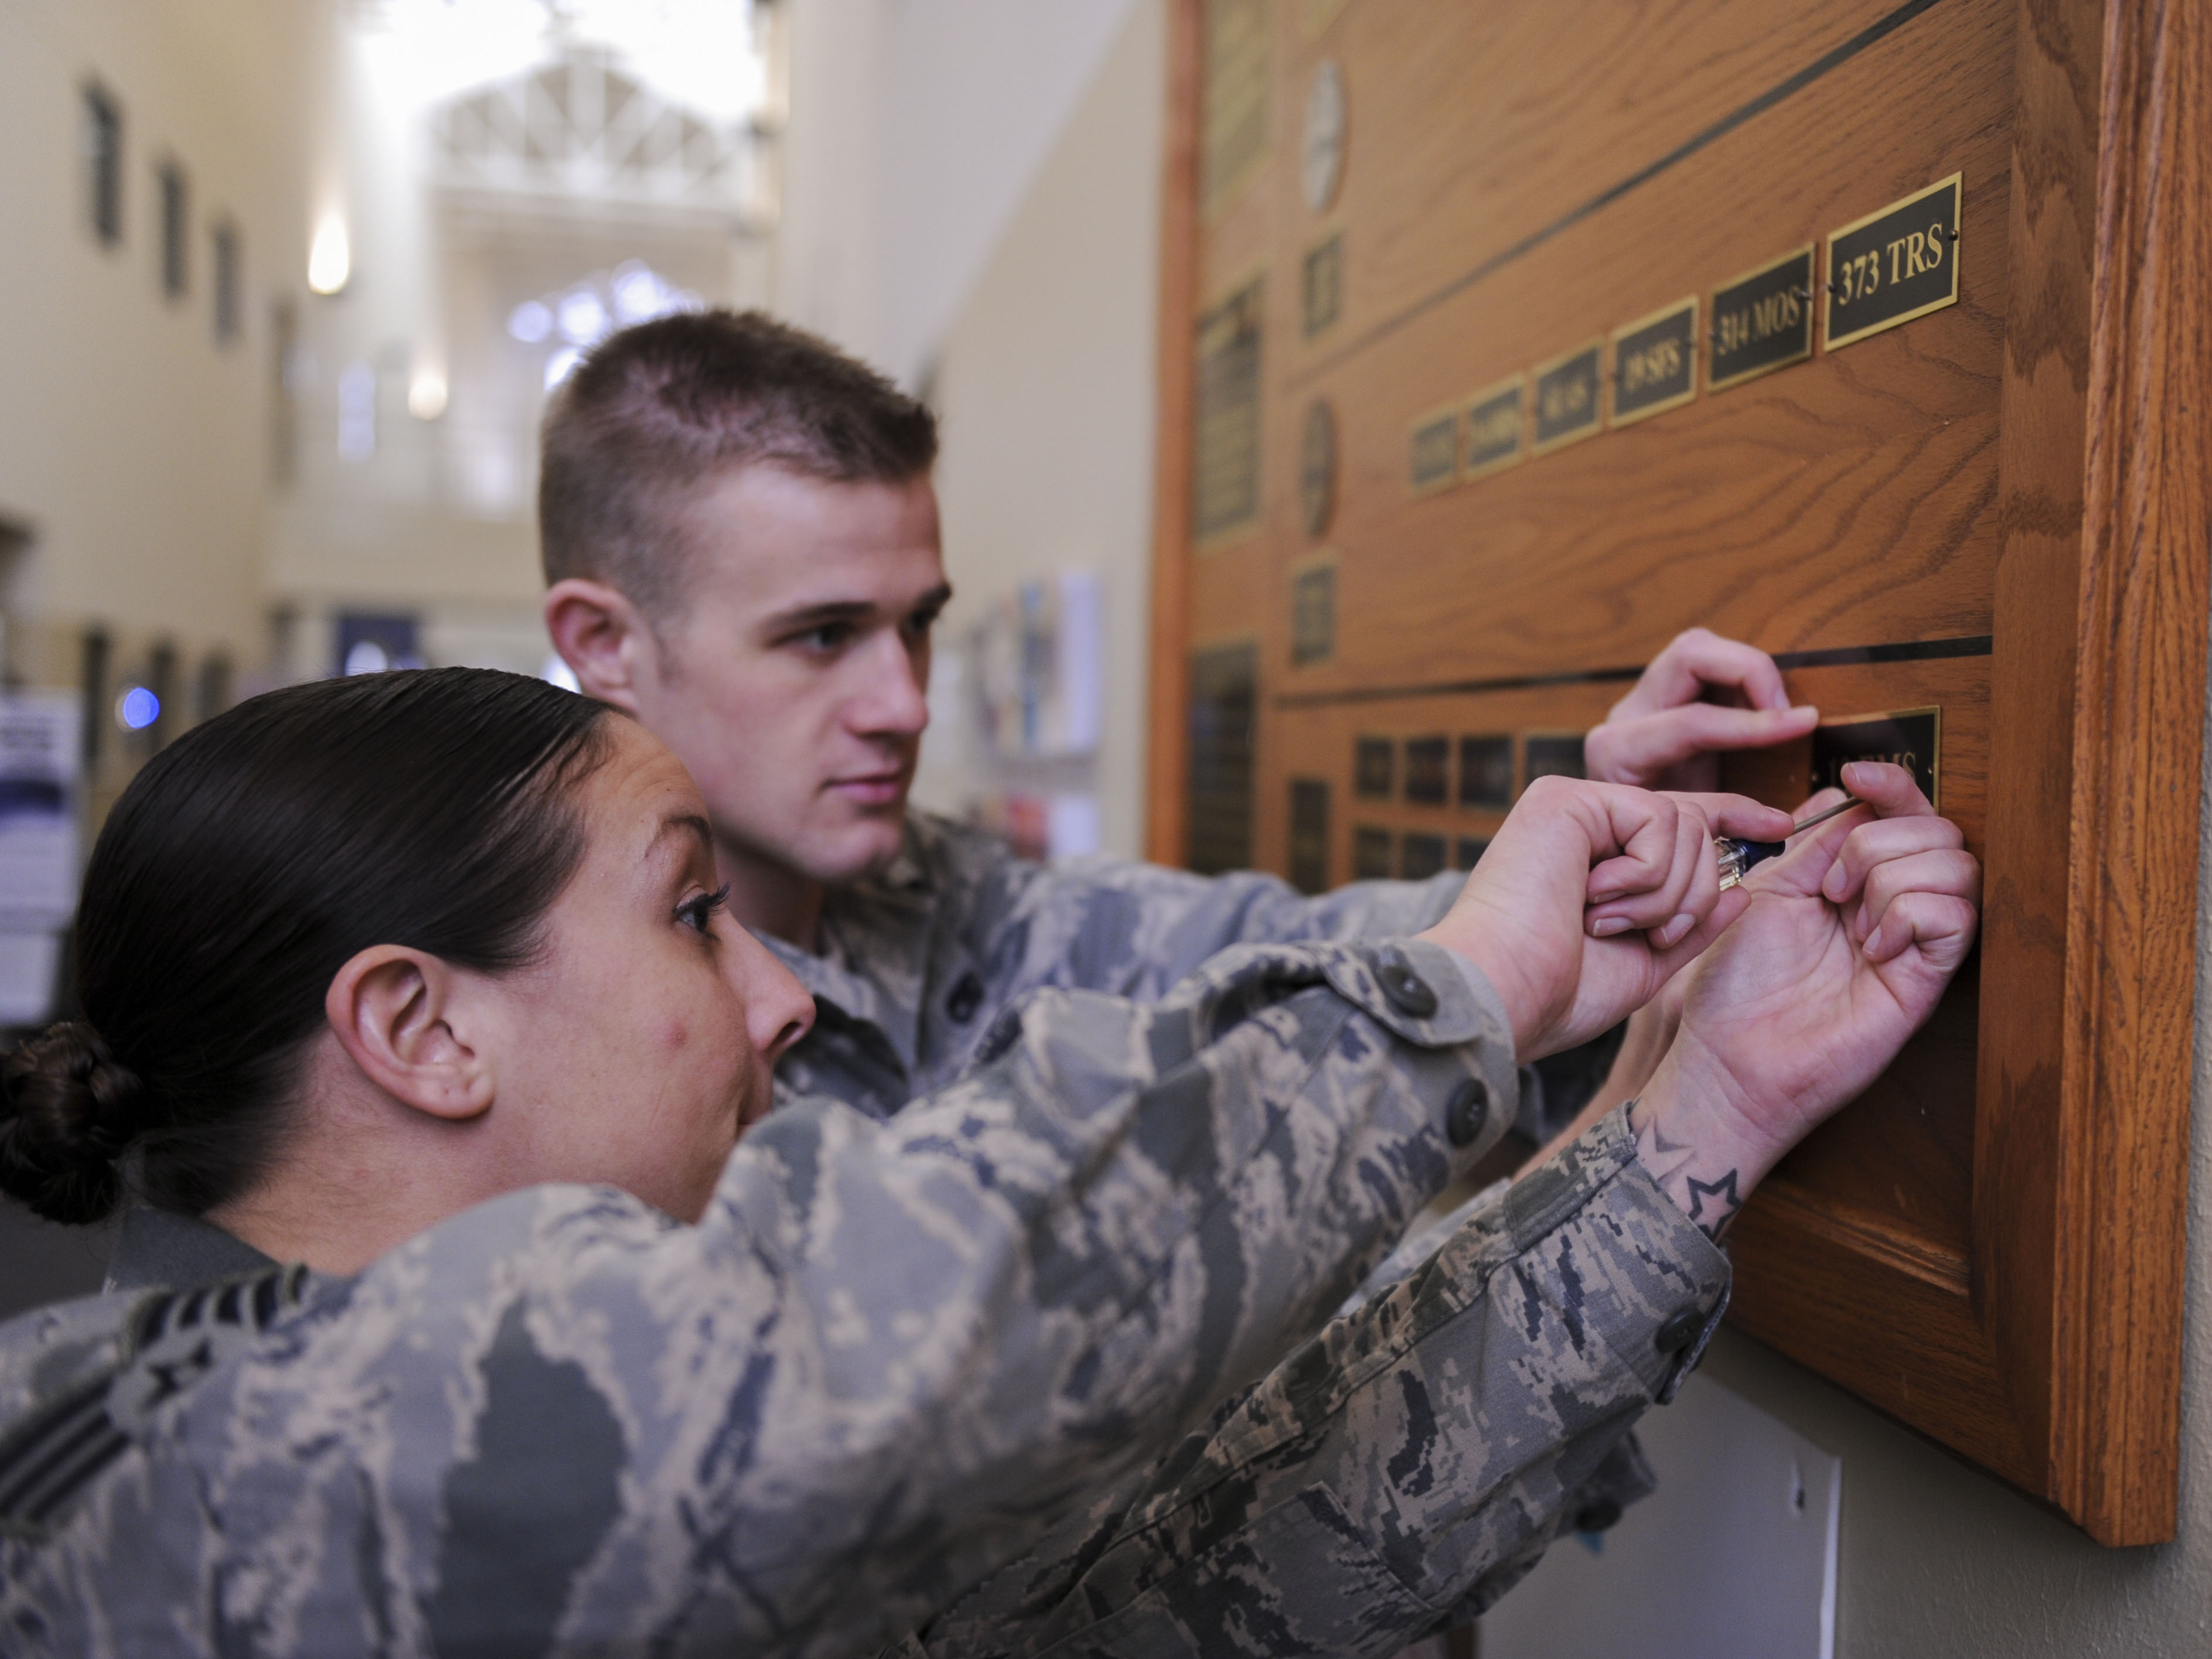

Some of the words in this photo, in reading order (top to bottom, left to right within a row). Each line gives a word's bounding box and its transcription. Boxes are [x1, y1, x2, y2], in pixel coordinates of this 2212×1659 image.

[1838, 250, 1880, 306] 373
[1886, 221, 1943, 286] TRS
[1753, 285, 1801, 340] MOS
